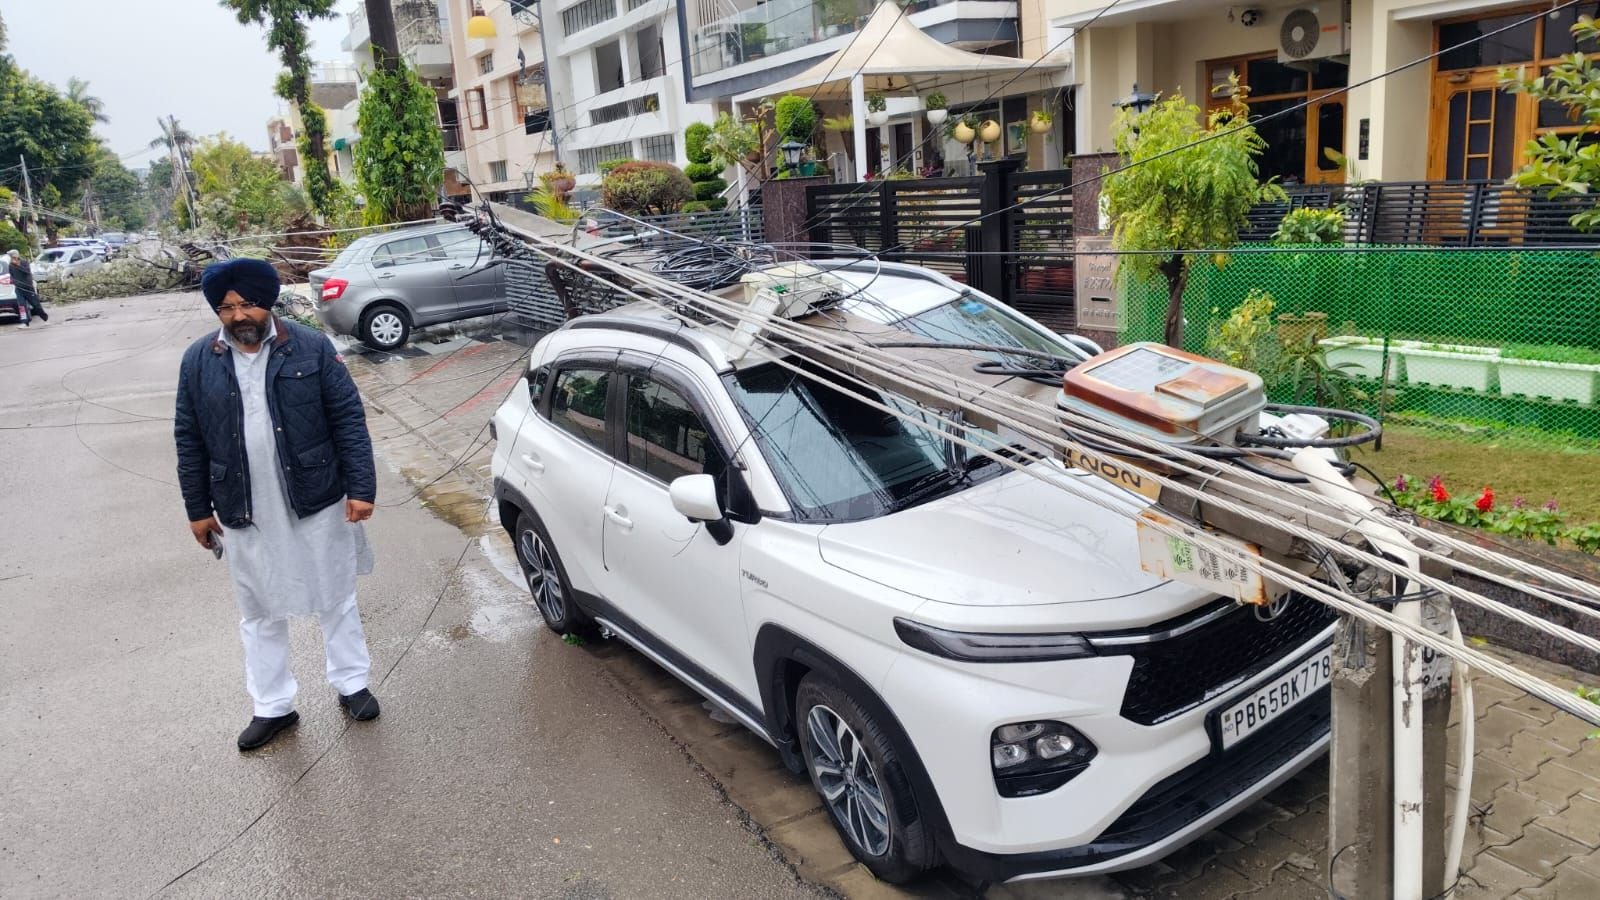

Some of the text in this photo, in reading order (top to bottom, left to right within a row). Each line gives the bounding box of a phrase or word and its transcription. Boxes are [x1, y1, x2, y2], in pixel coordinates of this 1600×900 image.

[1080, 454, 1141, 488] 202
[741, 568, 769, 588] TURBO
[1234, 655, 1331, 737] PB65BK778
